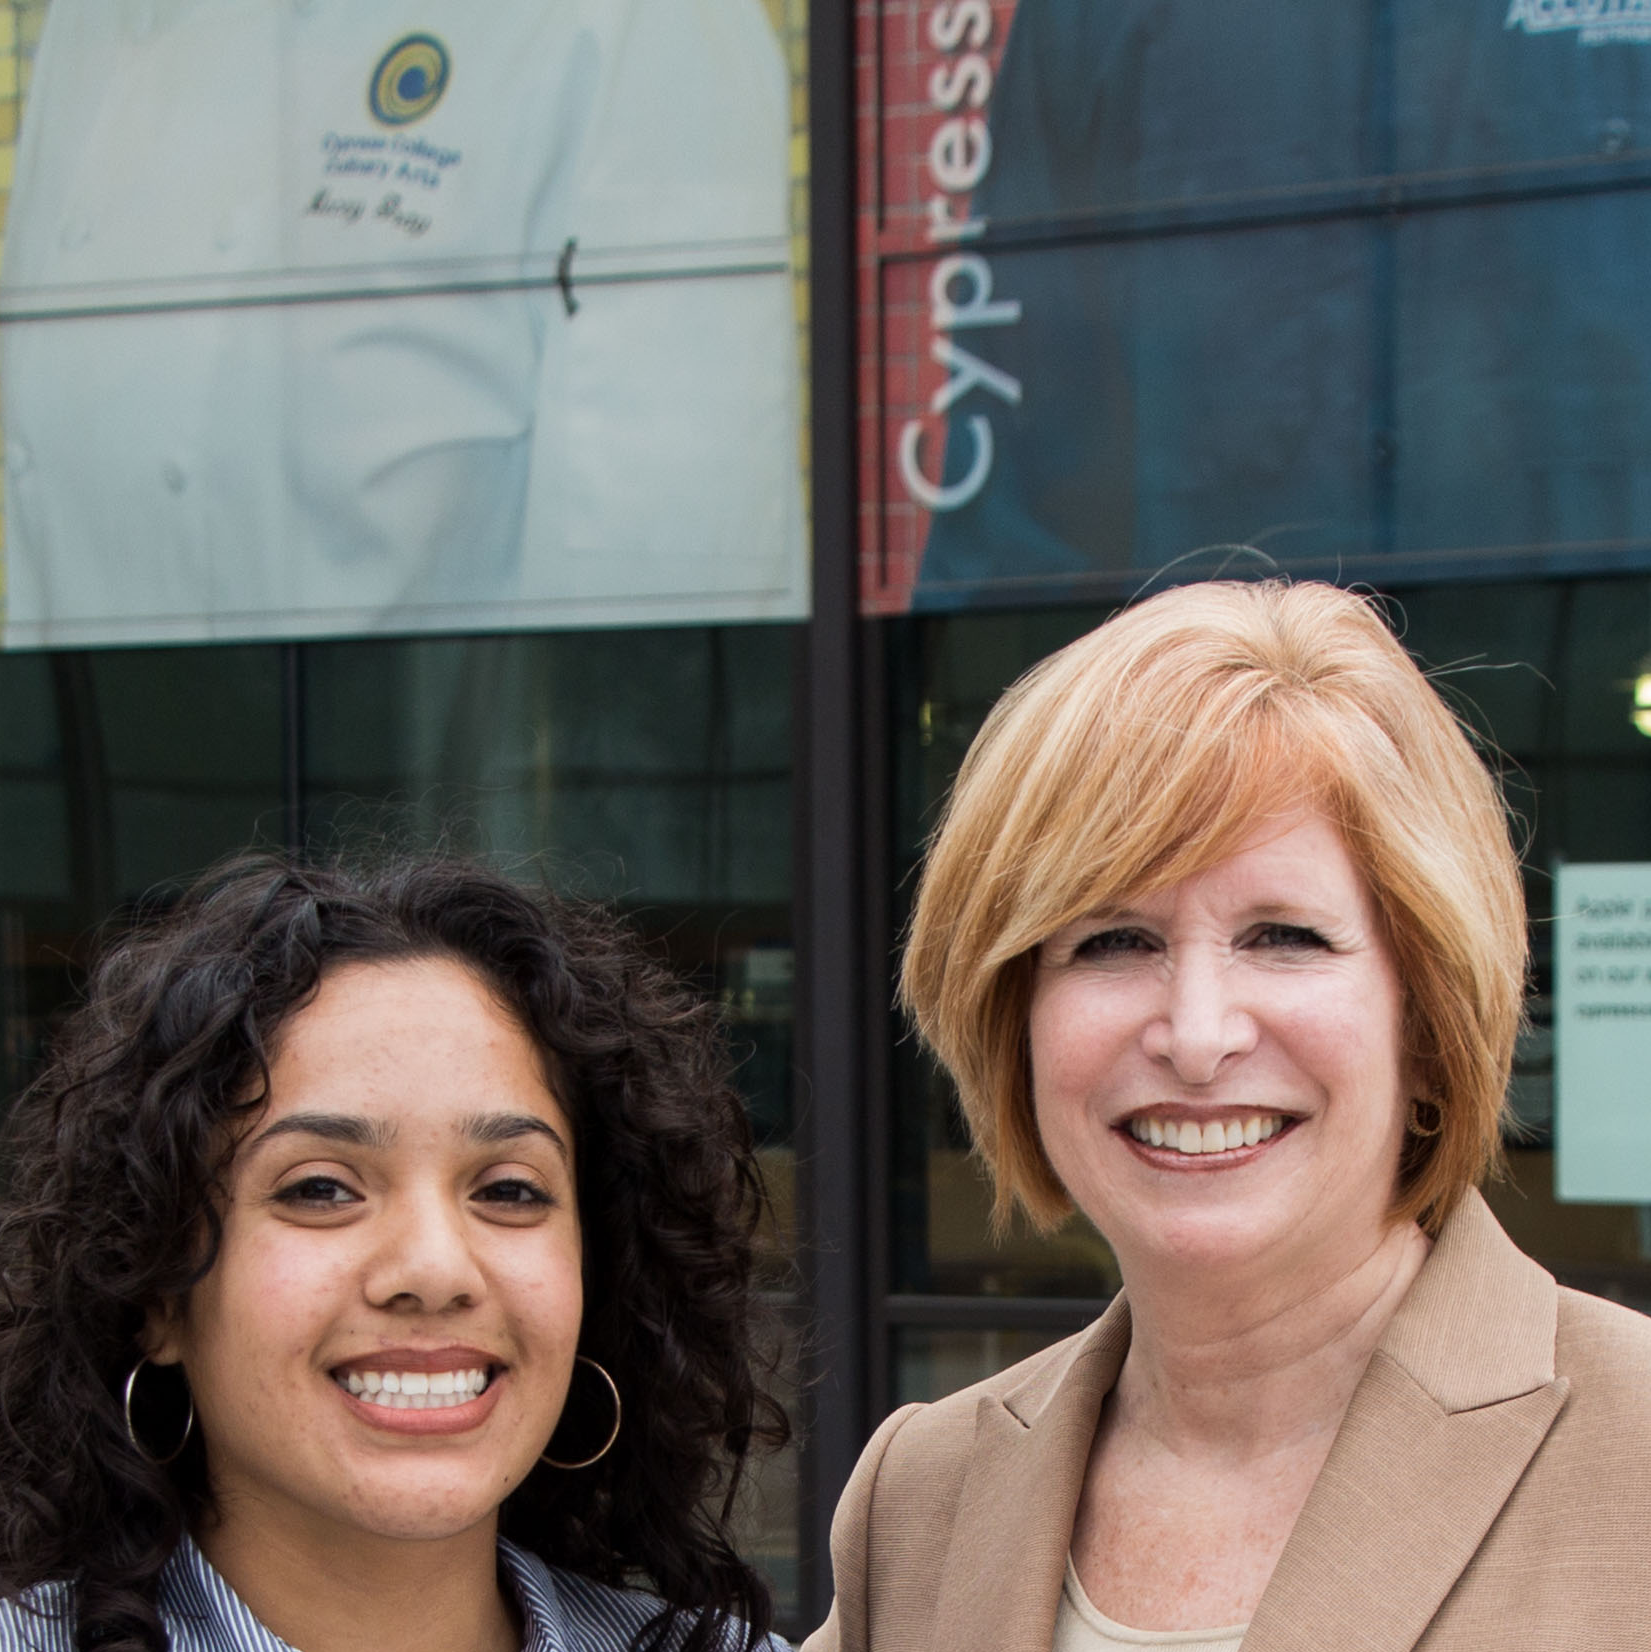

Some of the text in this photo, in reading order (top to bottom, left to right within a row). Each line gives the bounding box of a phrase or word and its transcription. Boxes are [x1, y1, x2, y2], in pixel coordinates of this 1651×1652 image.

[898, 0, 1023, 513] Cypress
[1576, 966, 1603, 983] on
[1605, 966, 1637, 983] our
